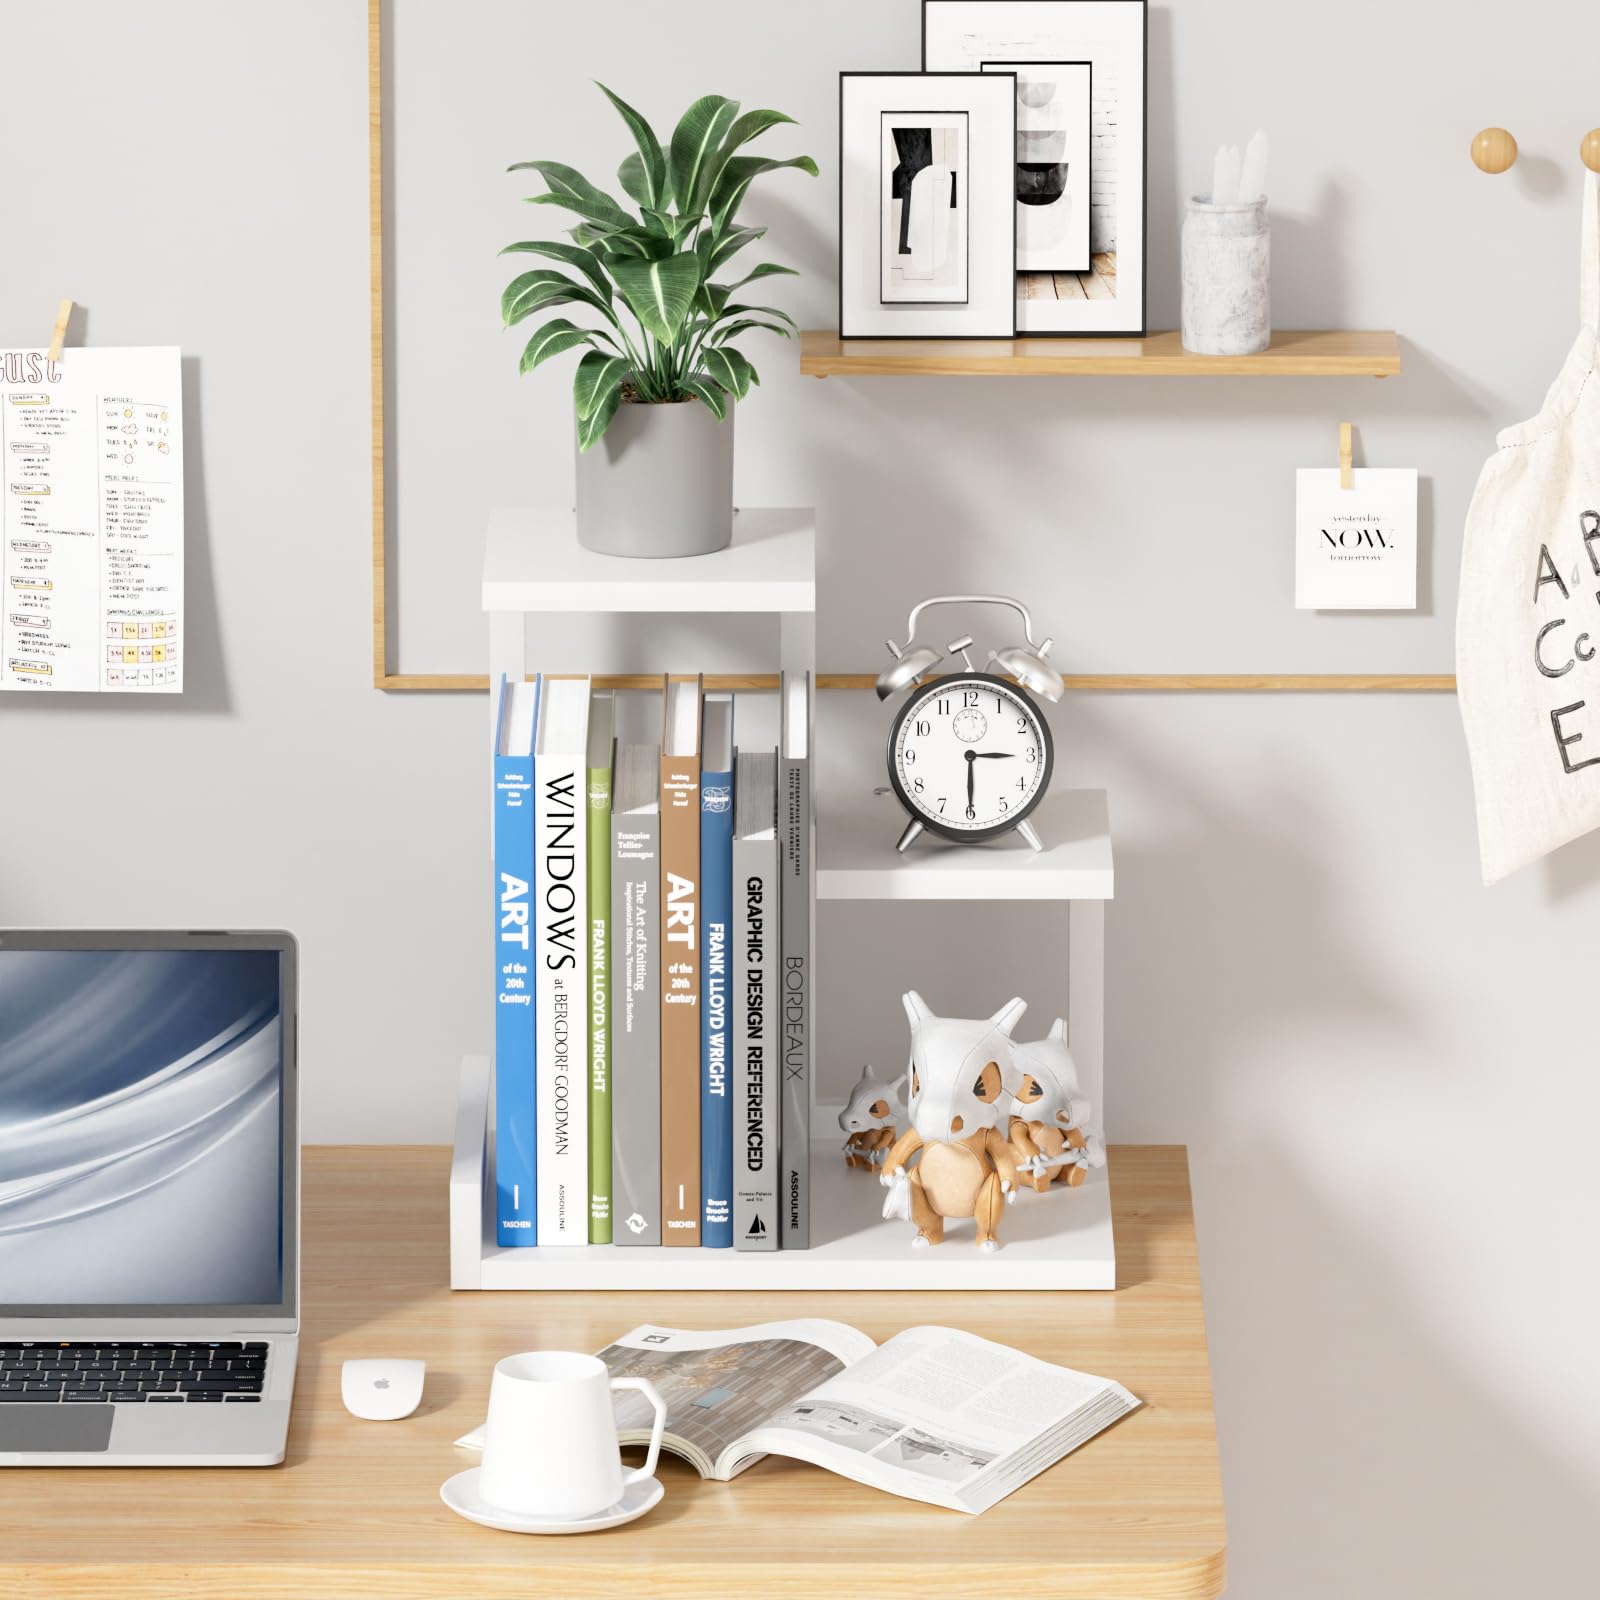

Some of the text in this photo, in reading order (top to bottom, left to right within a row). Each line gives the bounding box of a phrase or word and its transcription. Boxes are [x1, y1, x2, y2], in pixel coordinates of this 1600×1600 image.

[1332, 513, 1382, 526] yesterday
[1319, 528, 1397, 549] NOW.
[937, 699, 950, 716] 11
[962, 691, 979, 708] 12
[995, 698, 1002, 714] 1
[915, 720, 931, 737] 10
[1016, 718, 1027, 734] 2
[905, 749, 916, 766] 9
[1025, 747, 1036, 764] 3
[913, 777, 925, 793] 8
[1015, 776, 1027, 791] 4
[937, 798, 948, 814] 7
[965, 804, 976, 821] 6
[999, 796, 1008, 812] 5
[545, 770, 576, 970] WINDOWS
[500, 872, 529, 950] ART
[666, 872, 695, 950] ART
[633, 880, 648, 991] The Art of Knitting
[503, 963, 528, 974] of the
[668, 962, 693, 974] of the
[505, 978, 525, 989] 20th
[671, 978, 690, 989] 20th
[499, 993, 531, 1006] Century
[592, 919, 606, 1093] FRANK LLOYD WRIGHT
[665, 993, 697, 1006] Century
[709, 923, 725, 1097] FRANK LLOYD WRIGHT
[785, 956, 804, 1081] BORDEAUX
[746, 876, 764, 1172] GRAPHIC DESIGN REFERENCED
[554, 978, 569, 1155] at BERGDORF GOODMAN
[790, 1170, 799, 1229] ASSOULINE
[502, 1220, 531, 1229] TASCHEN
[667, 1220, 697, 1229] TASCHEN
